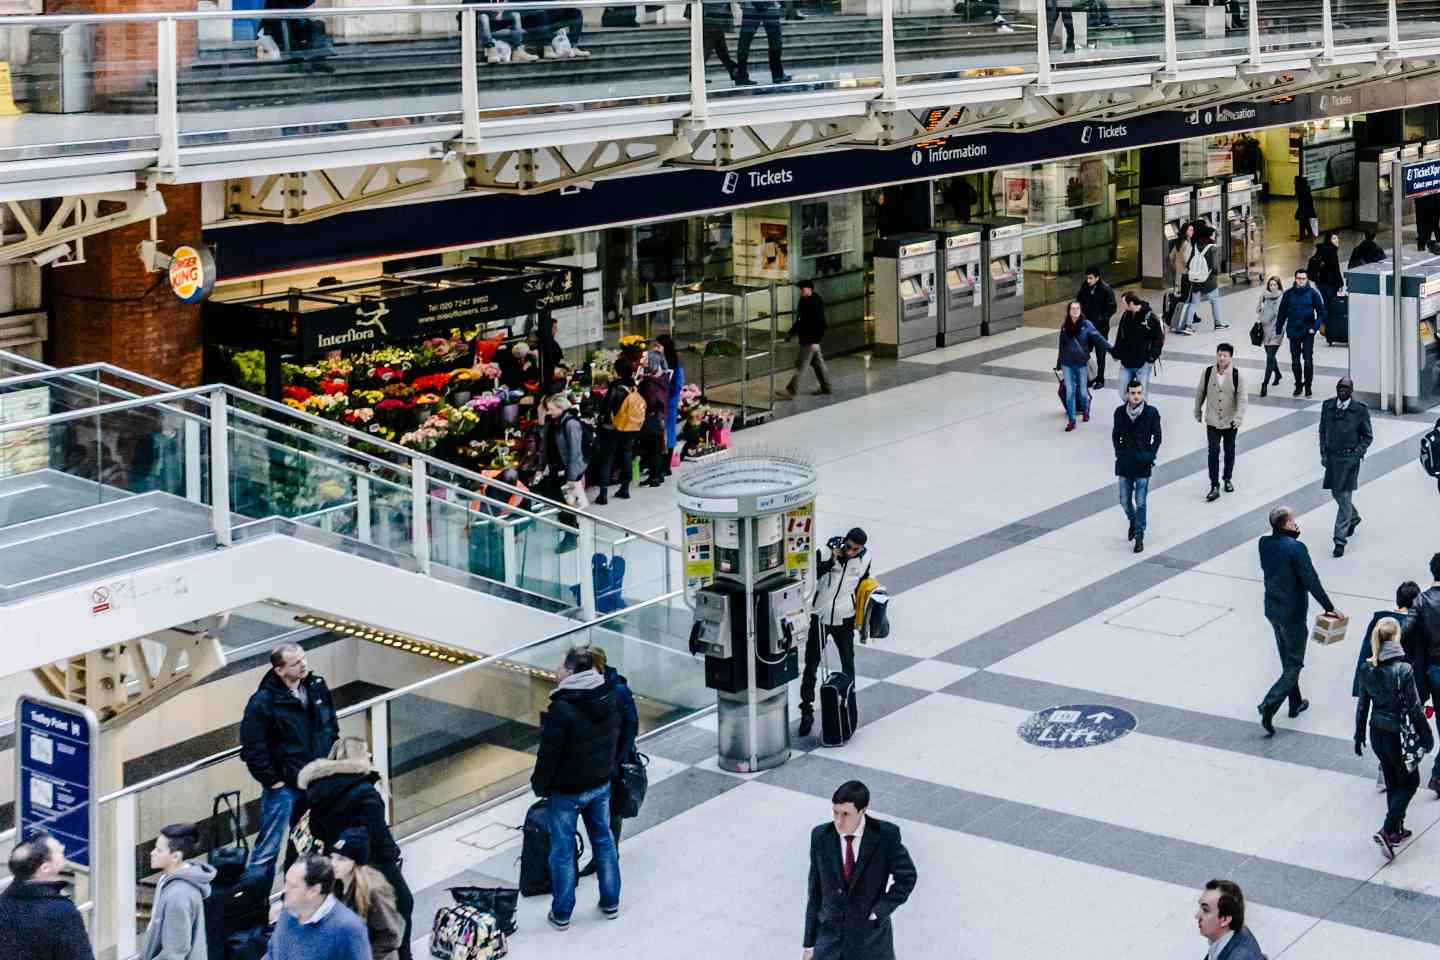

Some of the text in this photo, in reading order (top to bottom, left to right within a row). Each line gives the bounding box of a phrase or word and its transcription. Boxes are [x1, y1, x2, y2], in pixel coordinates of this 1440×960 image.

[1329, 95, 1352, 105] Tickets
[1098, 124, 1128, 139] Tickets
[929, 143, 988, 163] Information
[748, 168, 793, 187] Tickets
[170, 267, 199, 287] KING
[318, 329, 375, 348] Interflora
[1037, 724, 1101, 743] Lift
